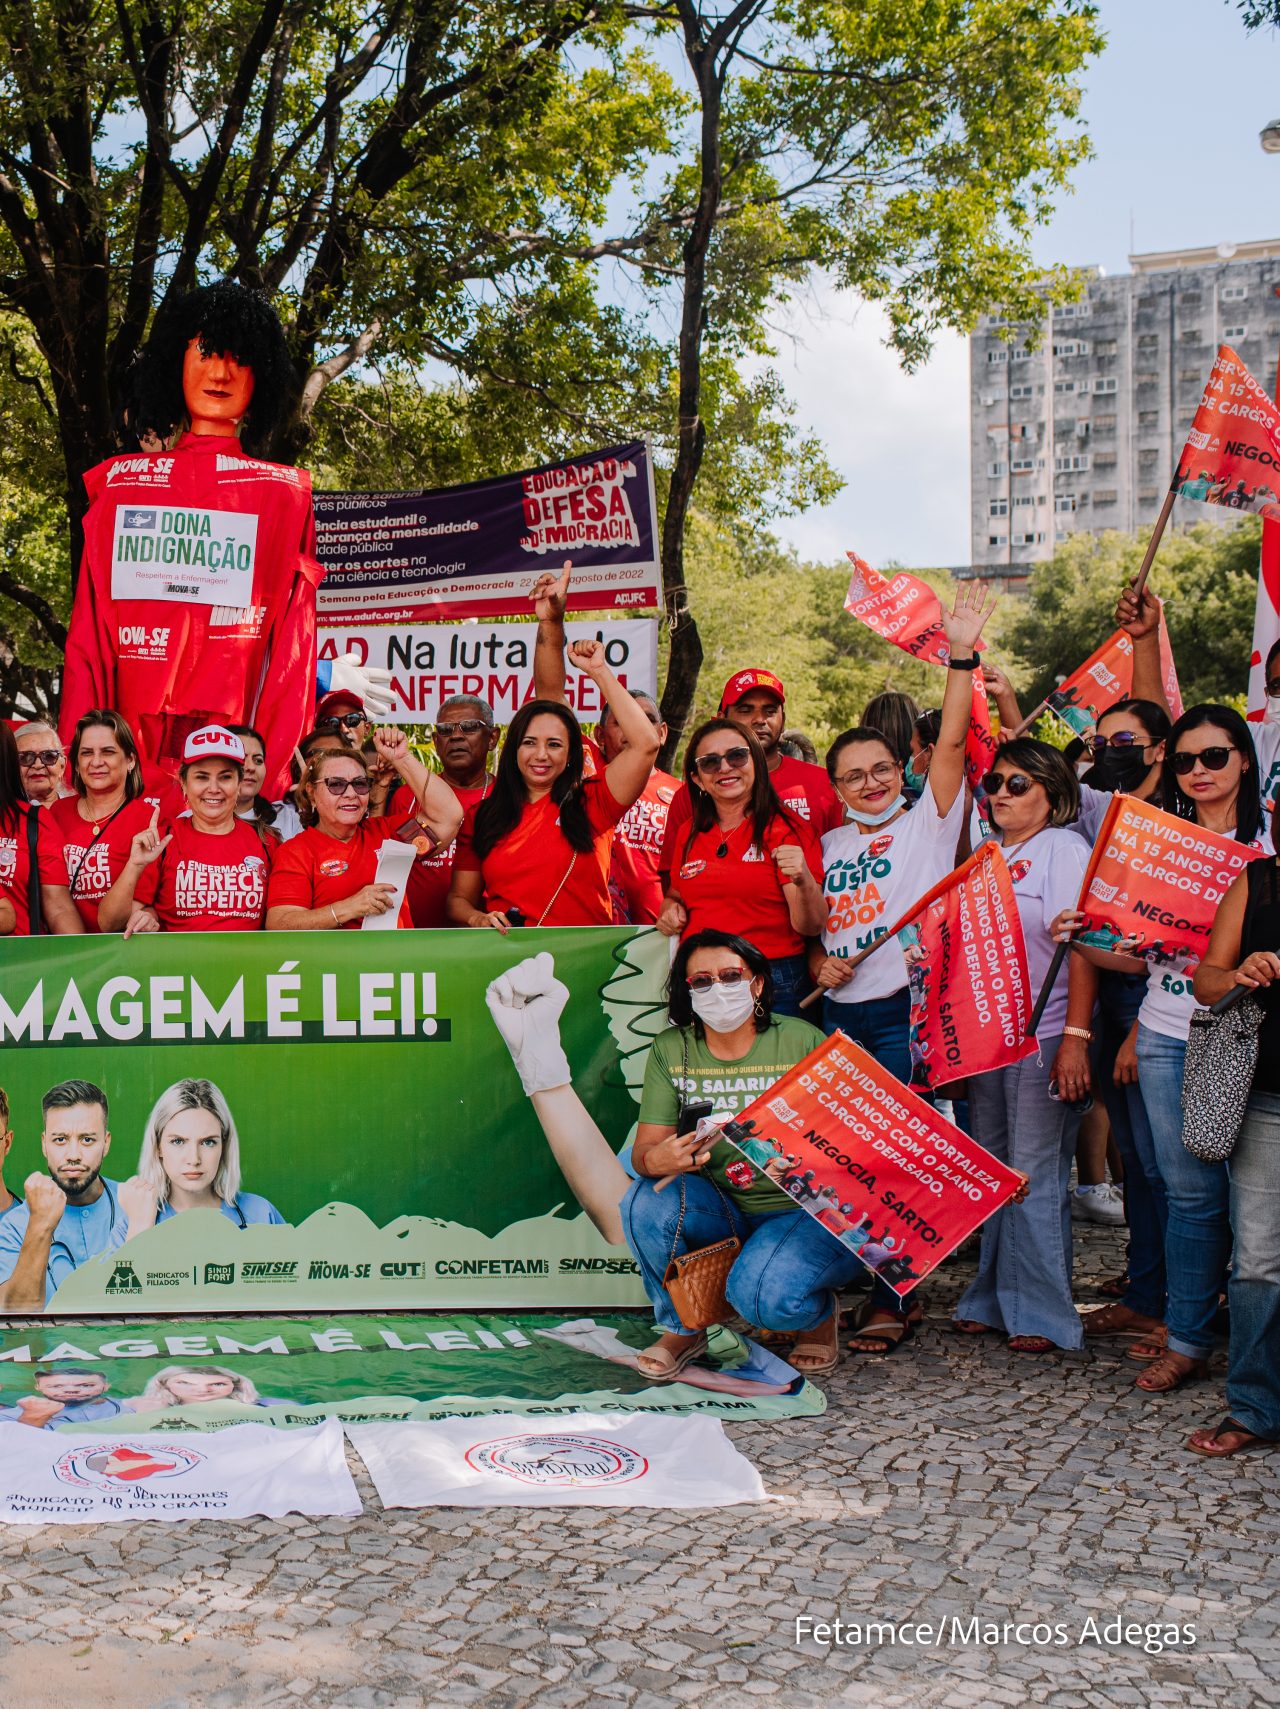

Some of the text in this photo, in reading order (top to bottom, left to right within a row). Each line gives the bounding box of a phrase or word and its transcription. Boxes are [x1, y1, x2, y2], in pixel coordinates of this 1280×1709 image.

[1229, 383, 1245, 397] 15
[522, 458, 617, 494] EDUCAÇÃO
[337, 500, 387, 512] públicos
[522, 486, 626, 526] DEFESA
[161, 511, 211, 537] DONA
[350, 514, 427, 530] estudantil e
[373, 520, 479, 540] de mensalidade
[529, 519, 632, 548] DEMOCRACIA
[117, 536, 251, 573] INDIGNAÇÃO
[350, 541, 393, 555] pública
[330, 561, 466, 582] na ciência e tecnologia
[345, 556, 427, 570] os cortes na
[167, 585, 200, 595] MOVA-SE
[319, 595, 361, 604] Semana
[363, 593, 386, 603] pela
[387, 586, 440, 600] Educação
[451, 580, 514, 594] Democracia
[520, 578, 531, 587] 22
[605, 572, 617, 581] de
[619, 569, 644, 580] 2022
[880, 588, 919, 620] PLANO
[329, 610, 413, 623] www.adufc.org.br
[387, 633, 527, 670] Na luta
[192, 732, 232, 746] CUT
[1122, 812, 1226, 862] SERVIDORES
[1114, 829, 1213, 878] HÁ 15 ANOS
[176, 861, 185, 869] A
[1106, 846, 1202, 895] DE CARGOS
[176, 870, 264, 892] MERECE
[176, 891, 264, 910] RESPEITO!
[958, 883, 992, 1028] CARGOS DEFASADO.
[972, 876, 1015, 1047] 15 ANOS COM O PLANO
[266, 960, 303, 1037] É
[322, 972, 438, 1036] LEI!
[1001, 935, 1025, 1047] DE FORTALEZA
[939, 1002, 962, 1067] SARTO!
[828, 1049, 1001, 1193] SERVIDORES DE FORTALEZA
[797, 1074, 944, 1198] DE CARGOS DEFASADO.
[812, 1062, 982, 1202] HÁ 15 ANOS COM O PLANO
[803, 1129, 943, 1248] NEGOCIA, SARTO!
[146, 1272, 190, 1280] SINDICATOS
[207, 1267, 231, 1275] SINDI
[207, 1273, 231, 1282] FORT
[241, 1261, 298, 1276] SINTSEF
[308, 1263, 371, 1280] MOVA-SE
[380, 1263, 421, 1277] CUT
[435, 1260, 543, 1275] CONFETAM
[146, 1279, 180, 1287] FILIADOS
[311, 1329, 362, 1353] É
[379, 1329, 532, 1351] LEI!
[526, 1405, 581, 1415] CUT
[6, 1486, 228, 1505] SINDICATO SERVIDORES
[129, 1501, 227, 1510] DO CRATO
